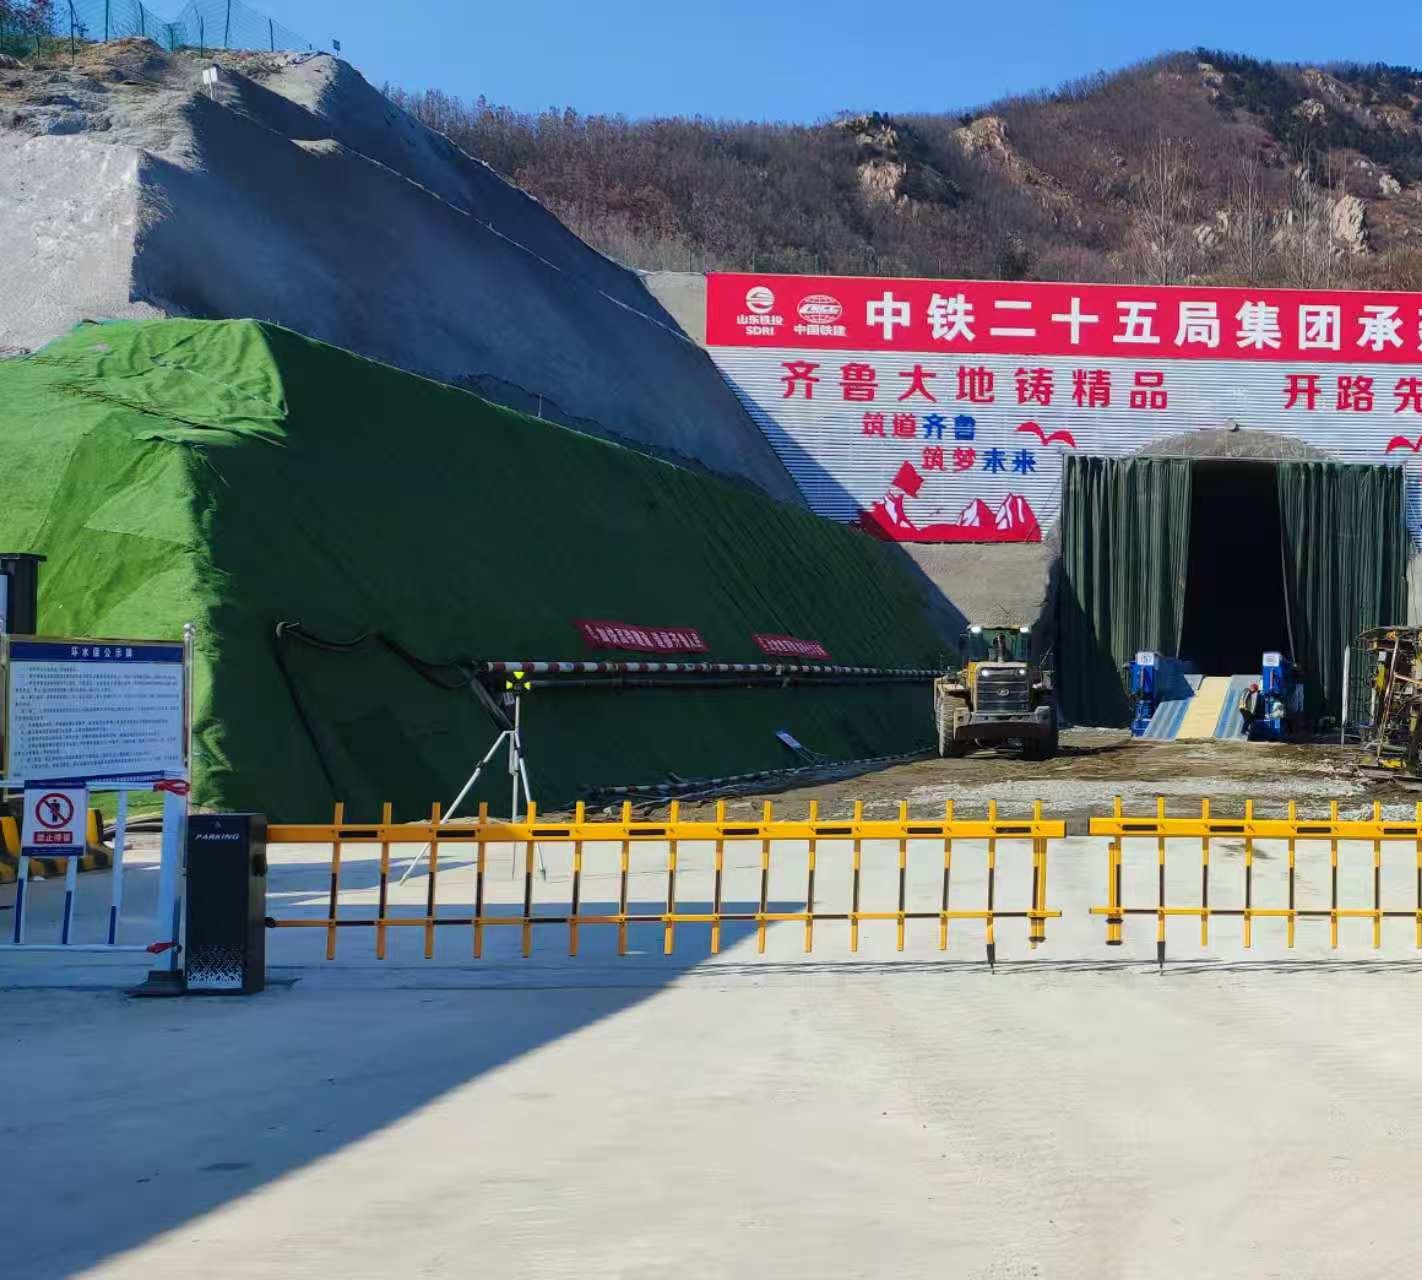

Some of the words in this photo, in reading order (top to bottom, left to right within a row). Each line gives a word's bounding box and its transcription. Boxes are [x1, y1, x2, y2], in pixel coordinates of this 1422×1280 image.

[745, 326, 775, 336] SDRI
[793, 324, 848, 337] 中国铁建
[780, 360, 1168, 410] 齐鲁大地铸精品
[863, 412, 977, 441] 筑道齐鲁
[921, 446, 1037, 475] 筑梦未来
[194, 833, 241, 841] PARKING
